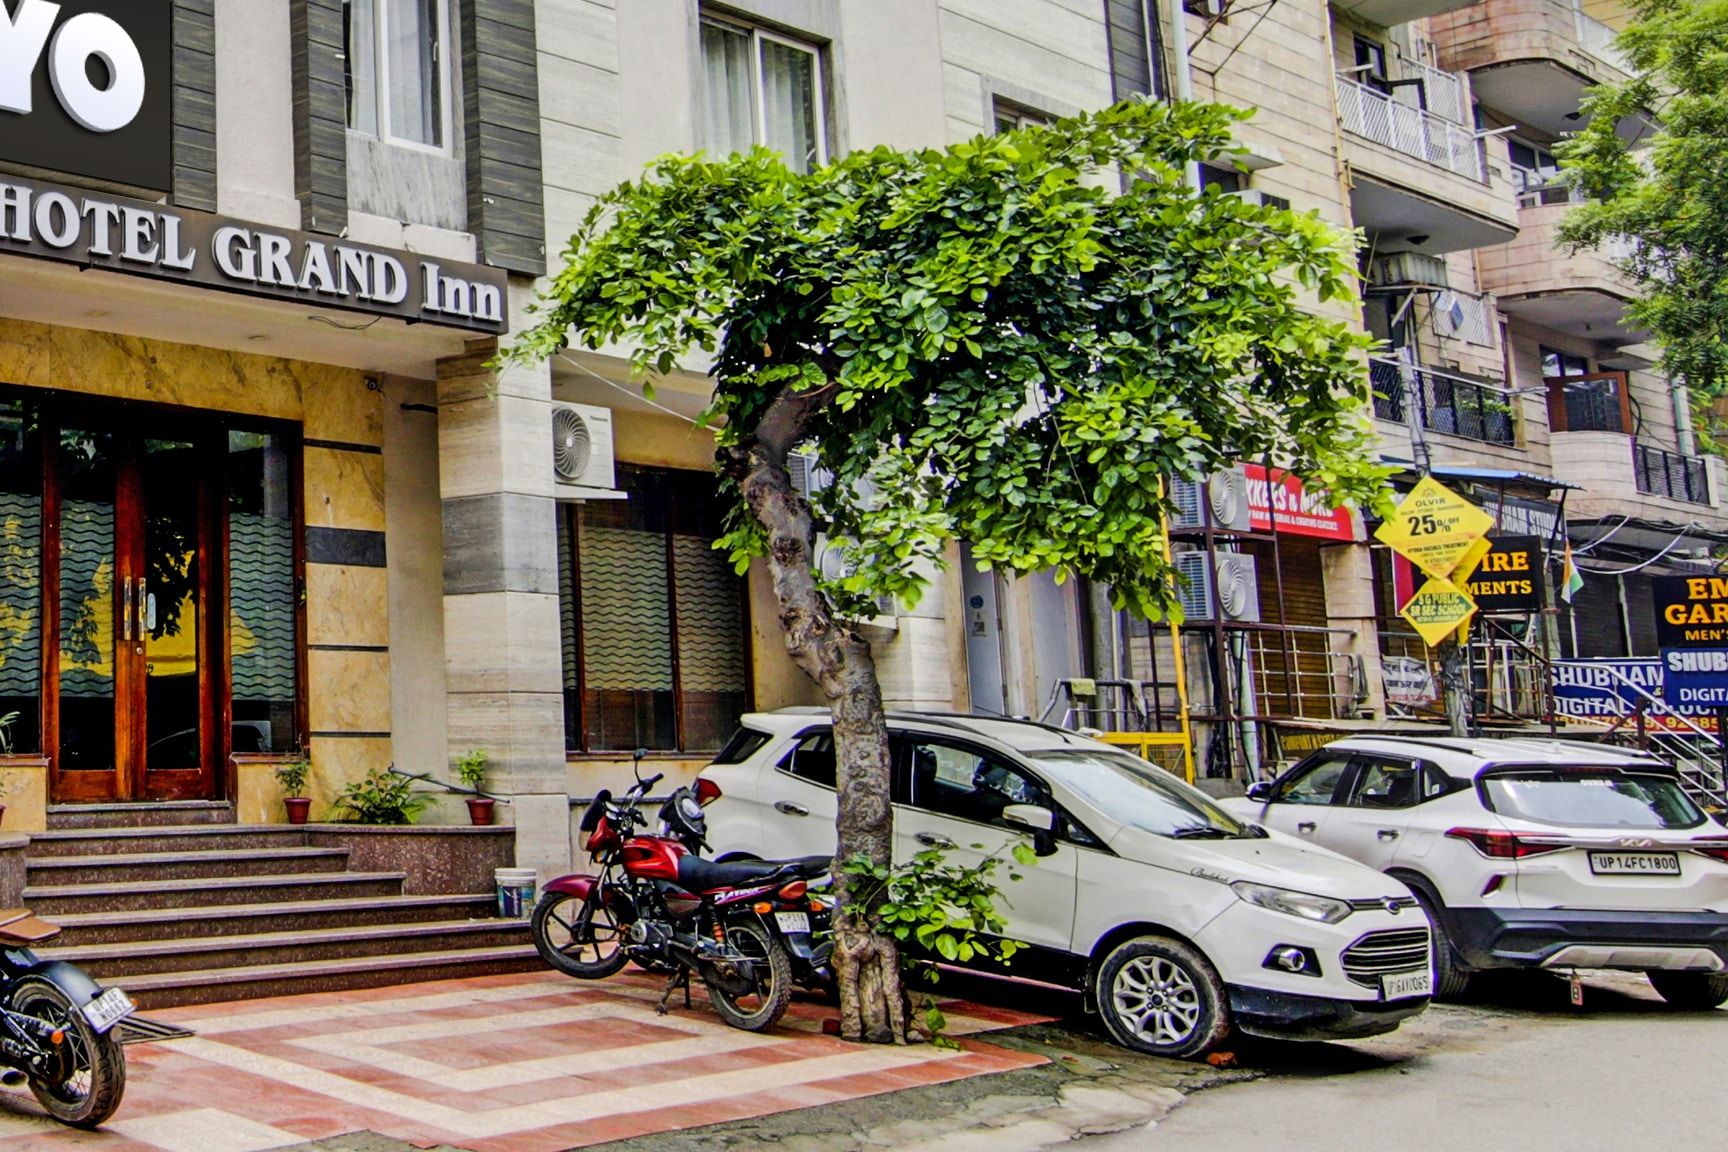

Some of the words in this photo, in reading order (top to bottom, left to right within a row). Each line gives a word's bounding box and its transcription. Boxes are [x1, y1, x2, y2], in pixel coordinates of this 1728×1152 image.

[211, 225, 408, 306] GRAND
[421, 262, 503, 324] Inn
[1685, 629, 1728, 641] MEN'
[1680, 688, 1728, 701] DIGIT
[1599, 857, 1677, 870] UP14FC1800
